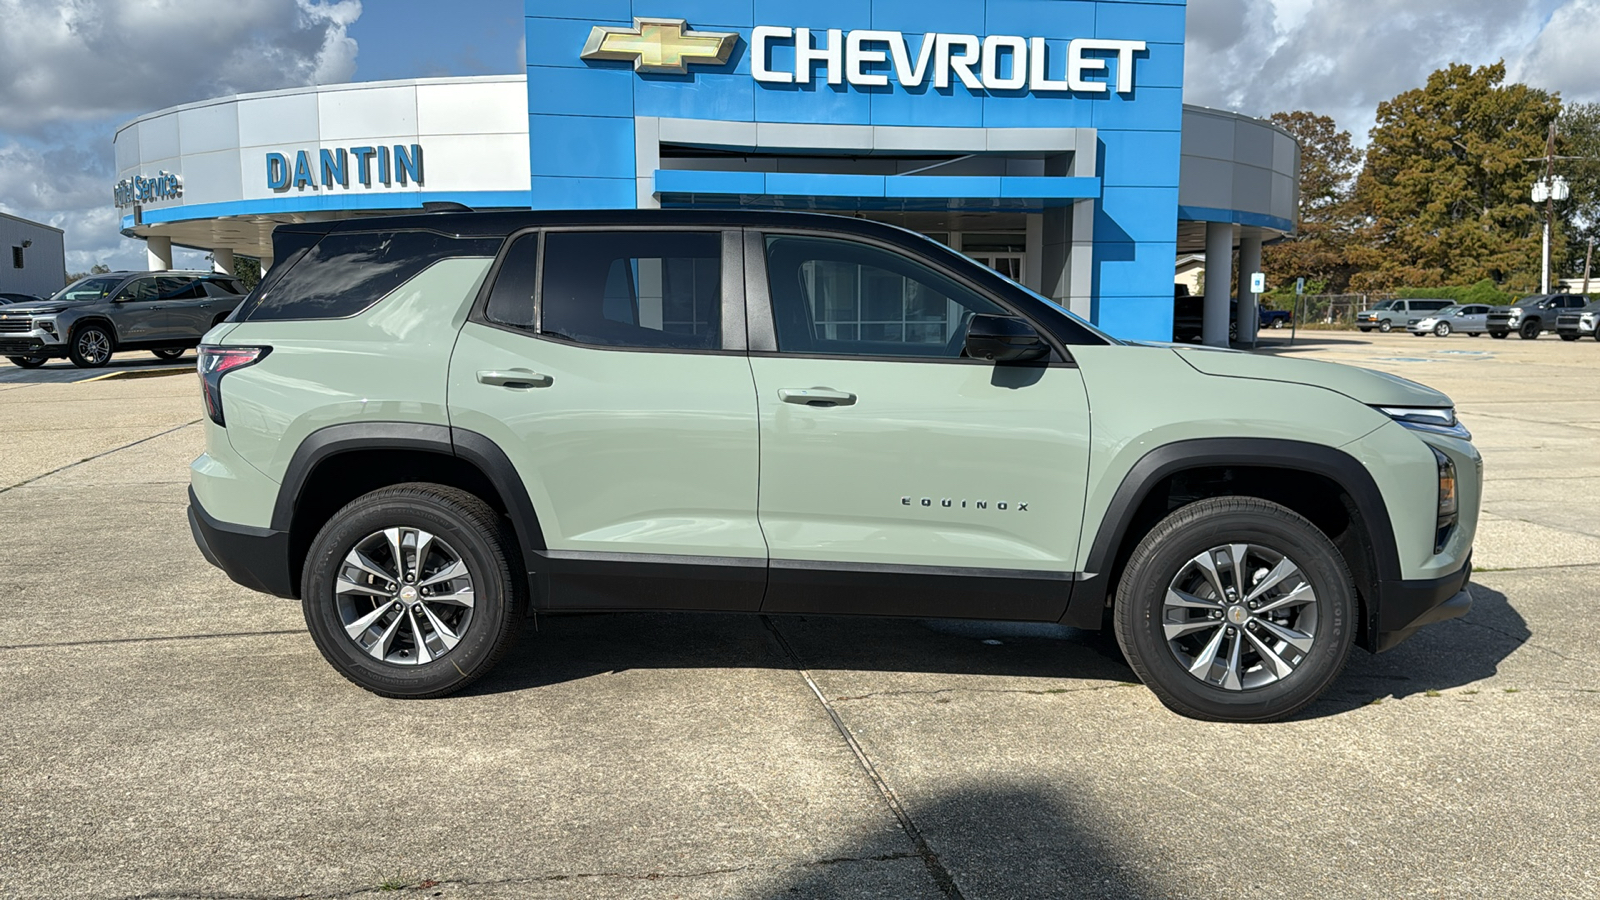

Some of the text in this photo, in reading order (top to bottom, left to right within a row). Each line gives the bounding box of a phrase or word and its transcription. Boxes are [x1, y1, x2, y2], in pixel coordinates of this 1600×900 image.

[750, 26, 1147, 94] CHEVROLET
[135, 170, 180, 199] Service
[266, 144, 423, 190] DANTIN
[901, 496, 1029, 512] EQUINOX
